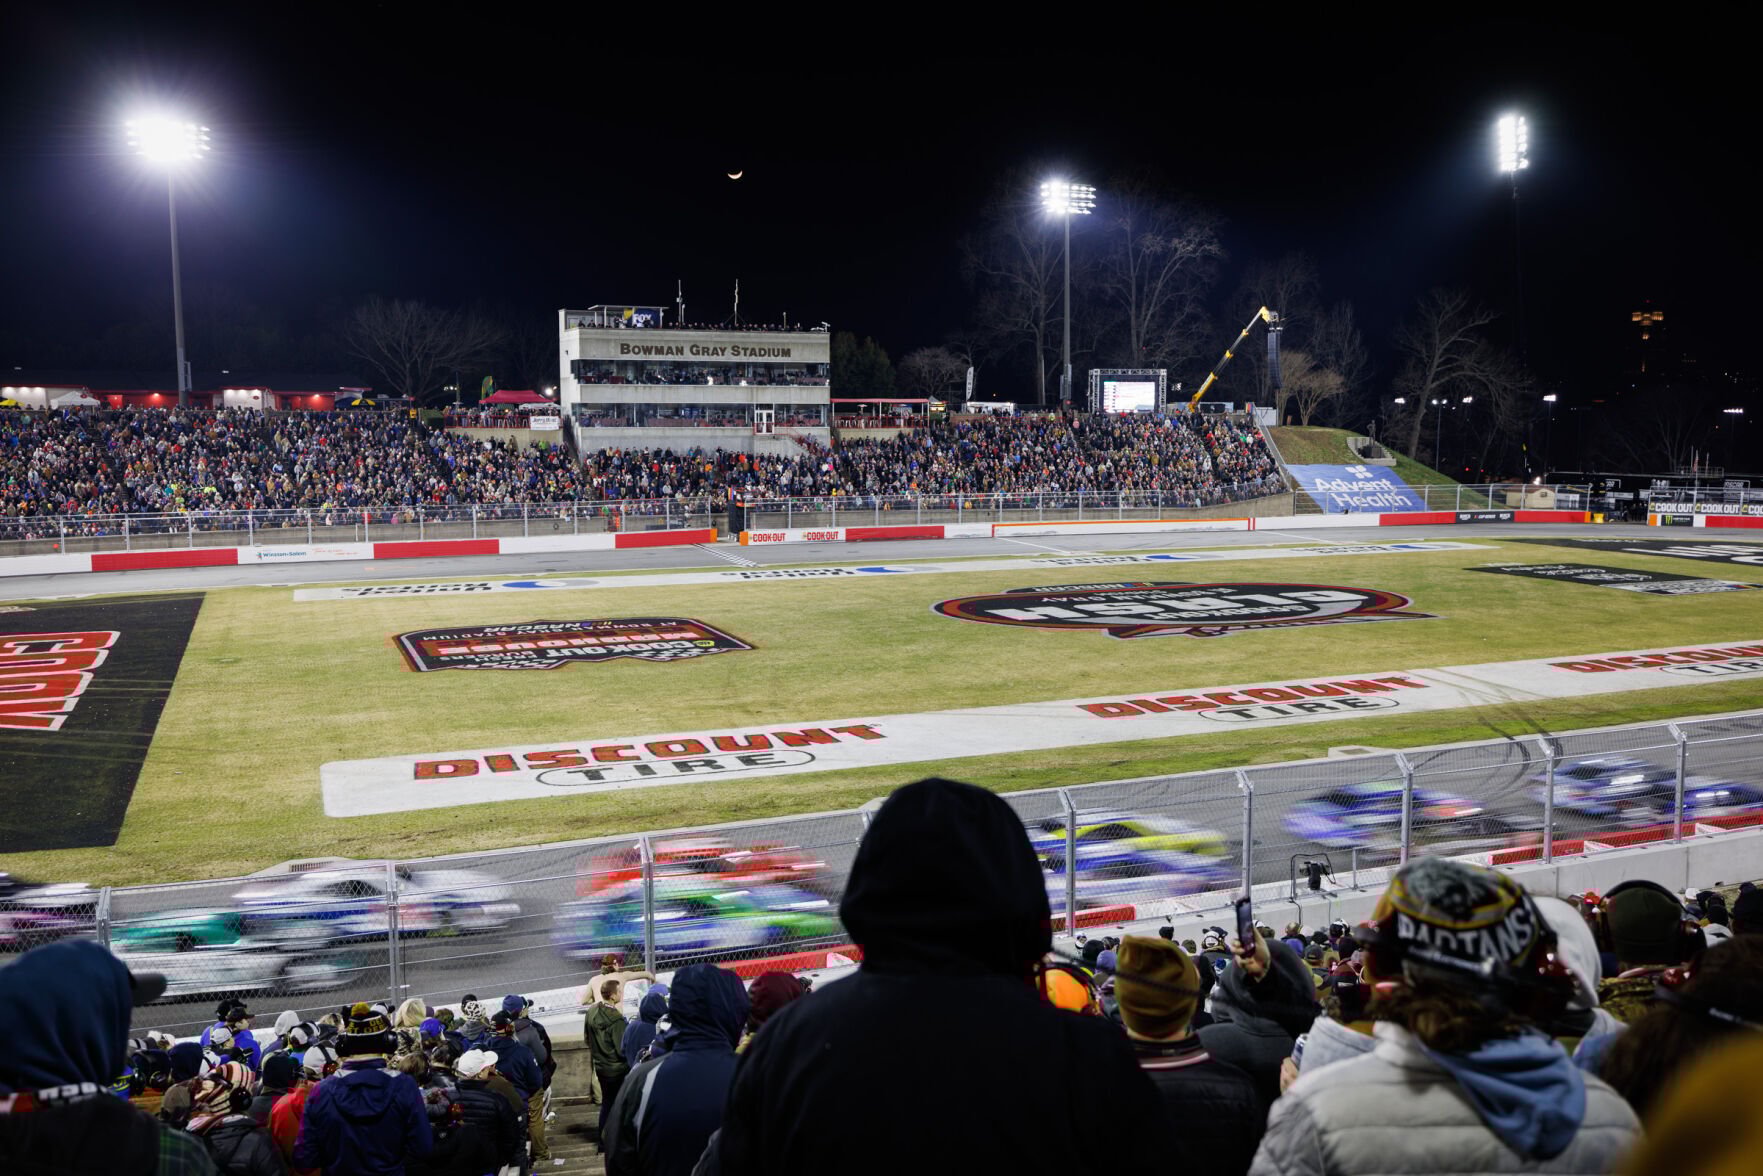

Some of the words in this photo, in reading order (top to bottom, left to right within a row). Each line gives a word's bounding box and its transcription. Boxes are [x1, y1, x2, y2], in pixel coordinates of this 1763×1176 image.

[620, 342, 684, 356] BOWMAN
[689, 344, 728, 357] GRAY
[731, 345, 792, 358] STADIUM
[1314, 478, 1395, 492] Advent
[1330, 492, 1413, 507] Health
[1655, 503, 1677, 513] COOK
[1677, 503, 1694, 513] OUT
[1701, 503, 1723, 514] COOK
[1723, 503, 1740, 514] OUT
[1033, 583, 1124, 592] NASCAR
[985, 590, 1368, 620] CLASH
[483, 622, 581, 633] NASCAR
[516, 627, 568, 635] GRAY
[421, 631, 506, 641] STADIUM
[437, 631, 701, 655] MADHOUSE
[604, 640, 696, 653] COOK
[545, 646, 607, 657] OUT
[1675, 661, 1763, 673] TIR
[1076, 677, 1430, 718] DISCOUNT
[1216, 697, 1381, 719] TIRE
[414, 724, 887, 780] DISCOUNT
[567, 752, 788, 782] TIRE
